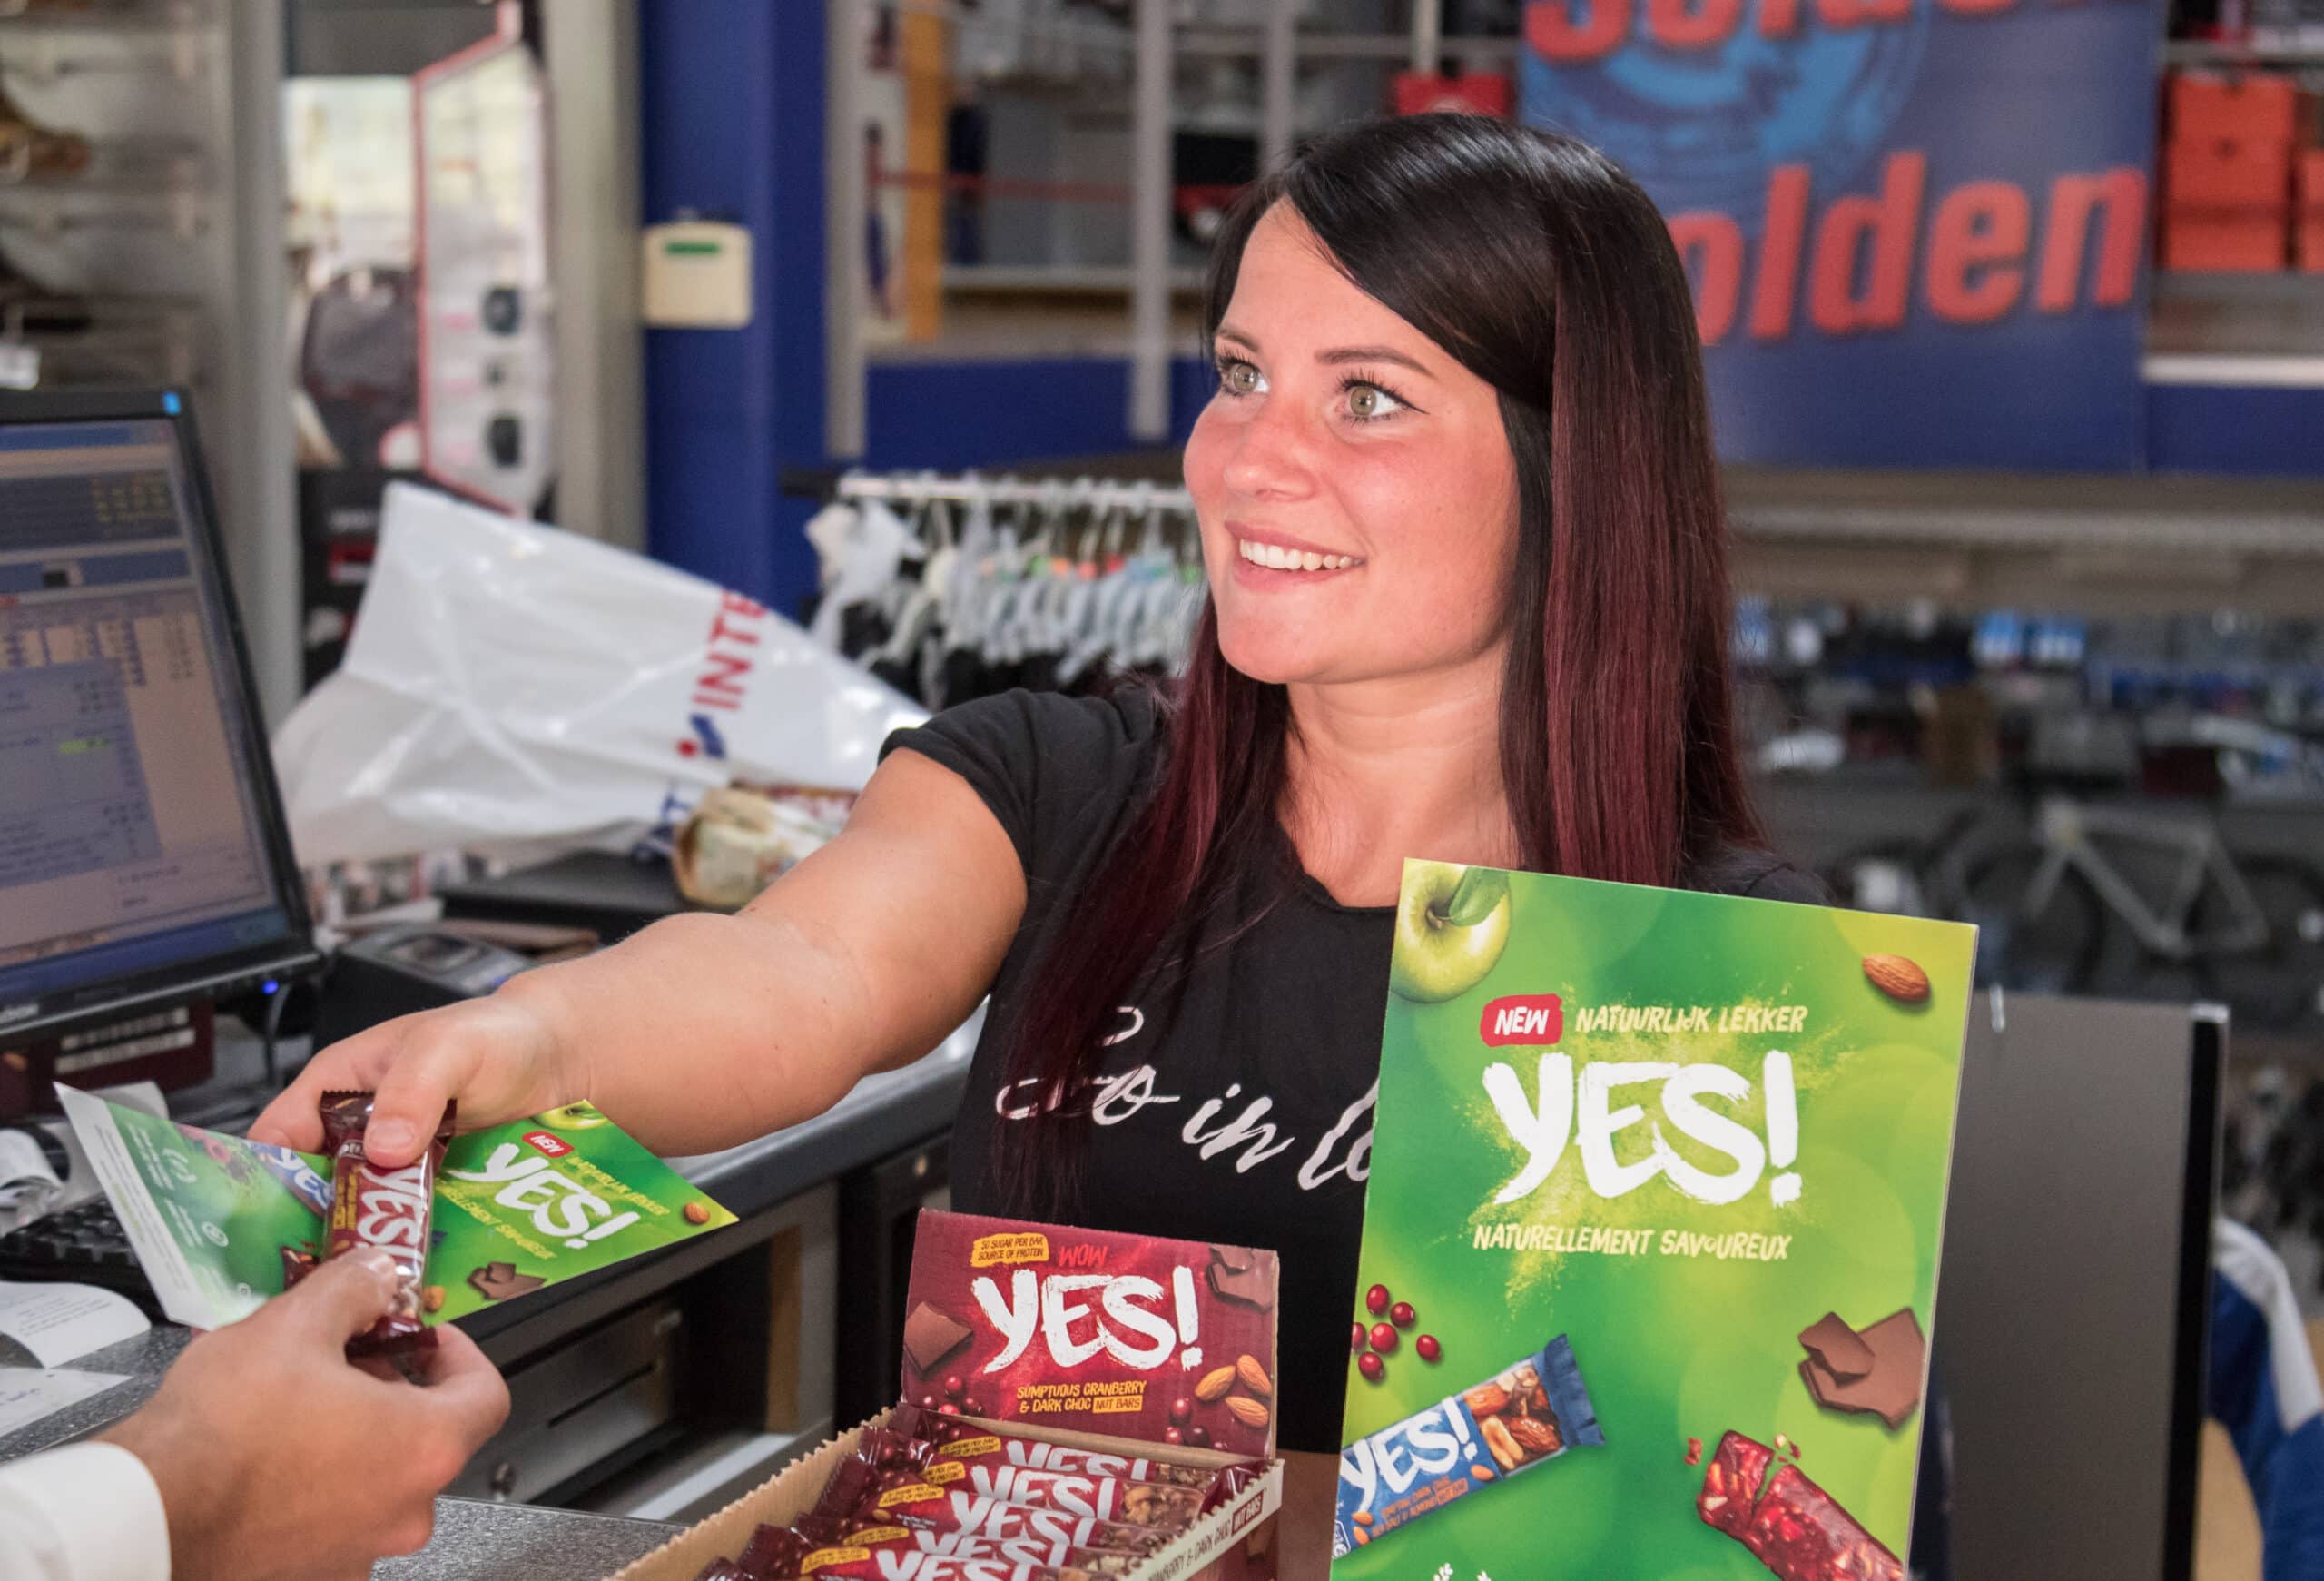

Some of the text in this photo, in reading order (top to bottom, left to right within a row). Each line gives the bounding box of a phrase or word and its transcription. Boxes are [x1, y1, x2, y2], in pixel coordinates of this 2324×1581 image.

[1667, 152, 2148, 346] olden
[1494, 1005, 1808, 1035] NEW NATUURLIJK LEKKER
[1482, 1050, 1803, 1208] YES!
[448, 1142, 641, 1250] YES!
[1058, 1244, 1108, 1268] WOW
[1472, 1223, 1656, 1256] NATURELLEMENT
[970, 1265, 1204, 1374] YES!
[1016, 1379, 1147, 1399] SUMPTUOUS CRANBERRY
[1019, 1397, 1141, 1414] & DARK CHOC NUT BARS
[1340, 1396, 1478, 1514] YES!
